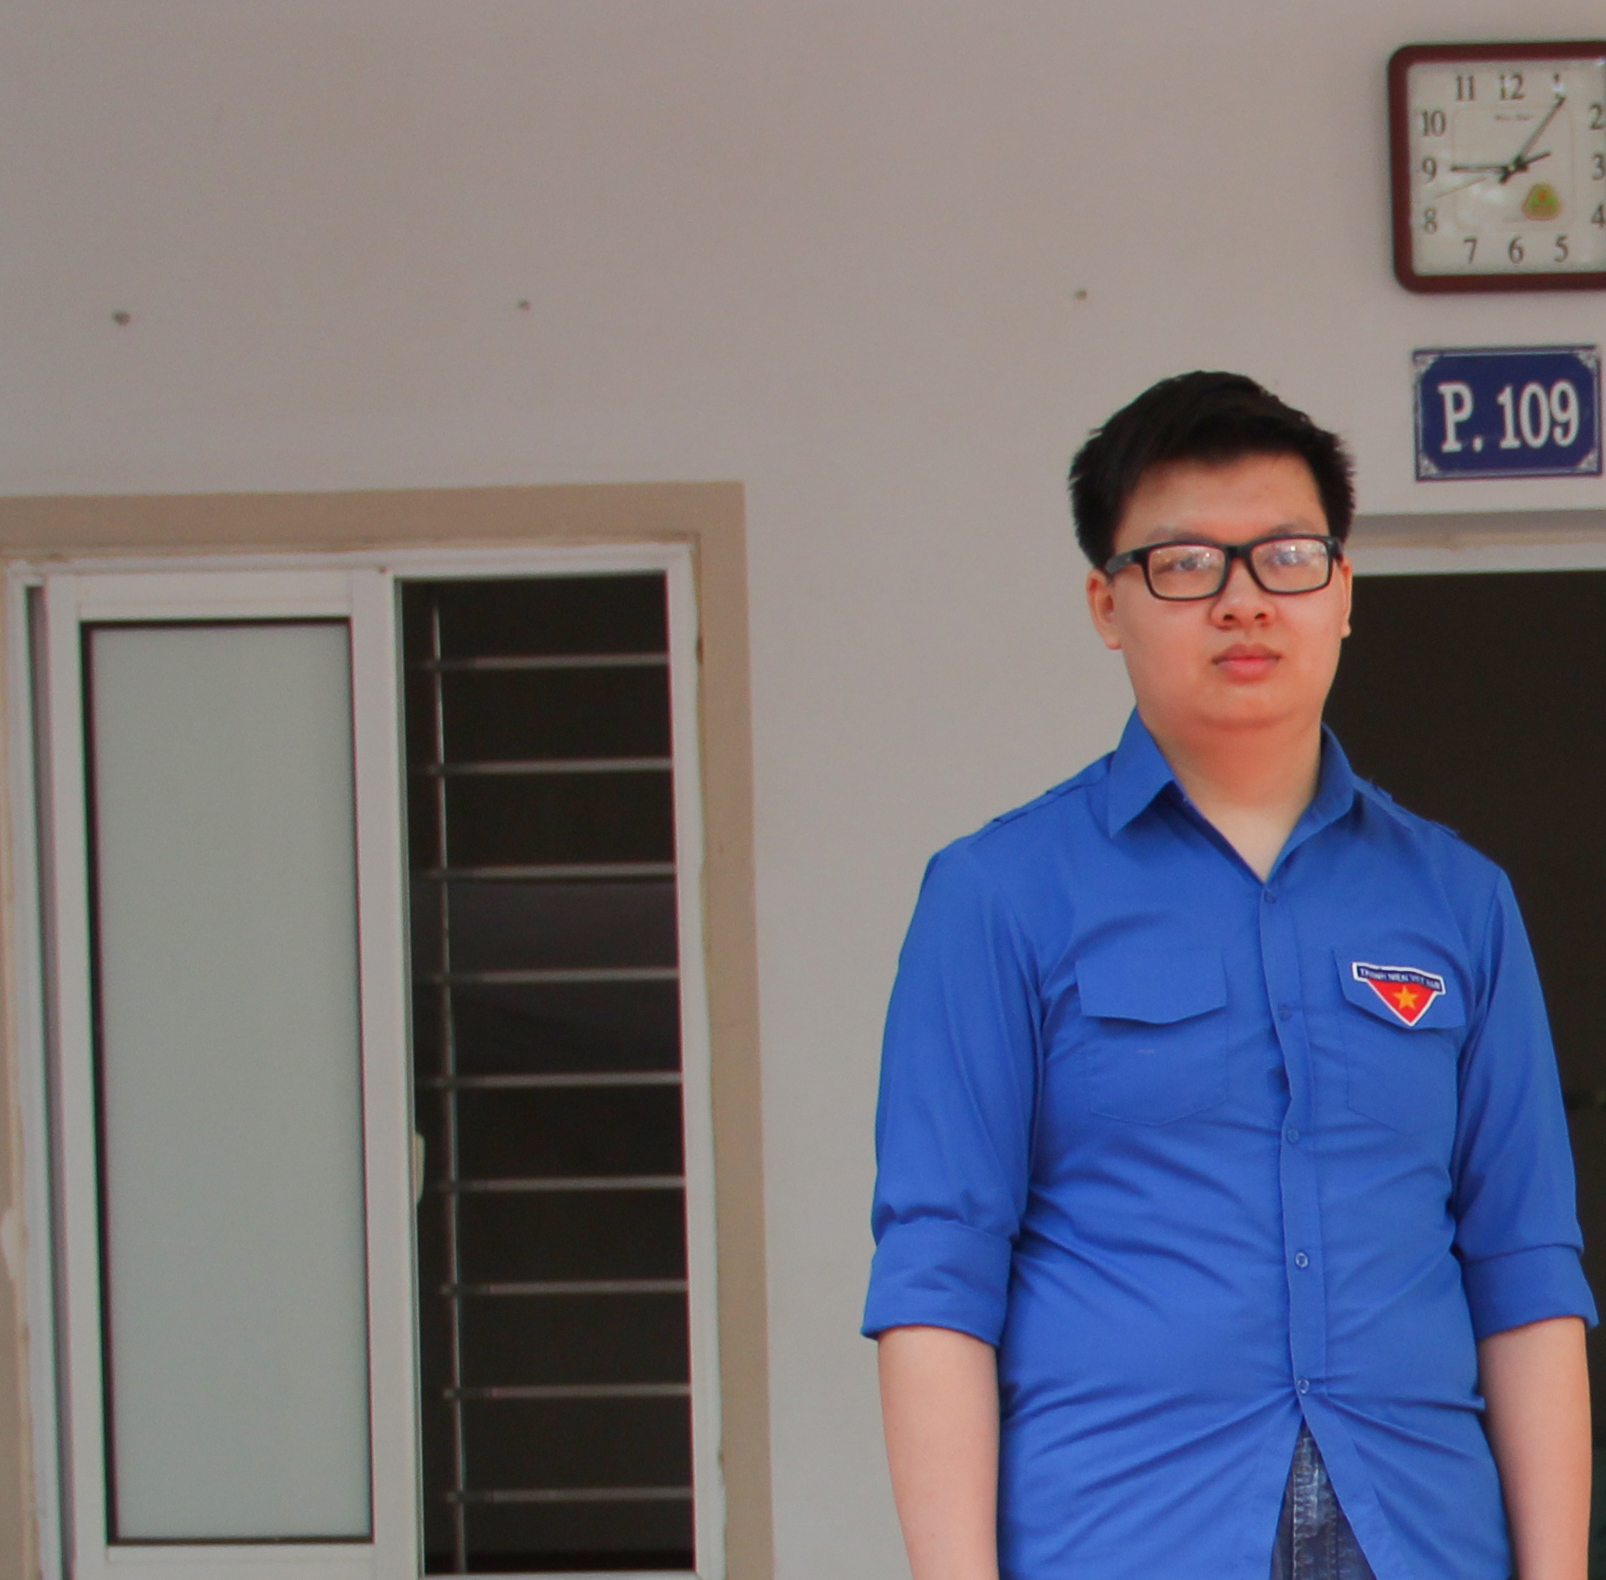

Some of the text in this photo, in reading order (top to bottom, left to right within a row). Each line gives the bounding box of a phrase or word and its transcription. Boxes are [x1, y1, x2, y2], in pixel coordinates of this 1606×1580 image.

[1454, 75, 1476, 101] 11
[1499, 73, 1525, 100] 12
[1421, 110, 1447, 137] 10
[1589, 104, 1605, 131] 2
[1421, 157, 1437, 183] 9
[1592, 153, 1606, 180] 3
[1423, 208, 1438, 235] 8
[1590, 203, 1606, 228] 4
[1463, 237, 1479, 264] 7
[1508, 236, 1525, 264] 6
[1553, 235, 1569, 262] 5
[1438, 379, 1580, 453] P. 109
